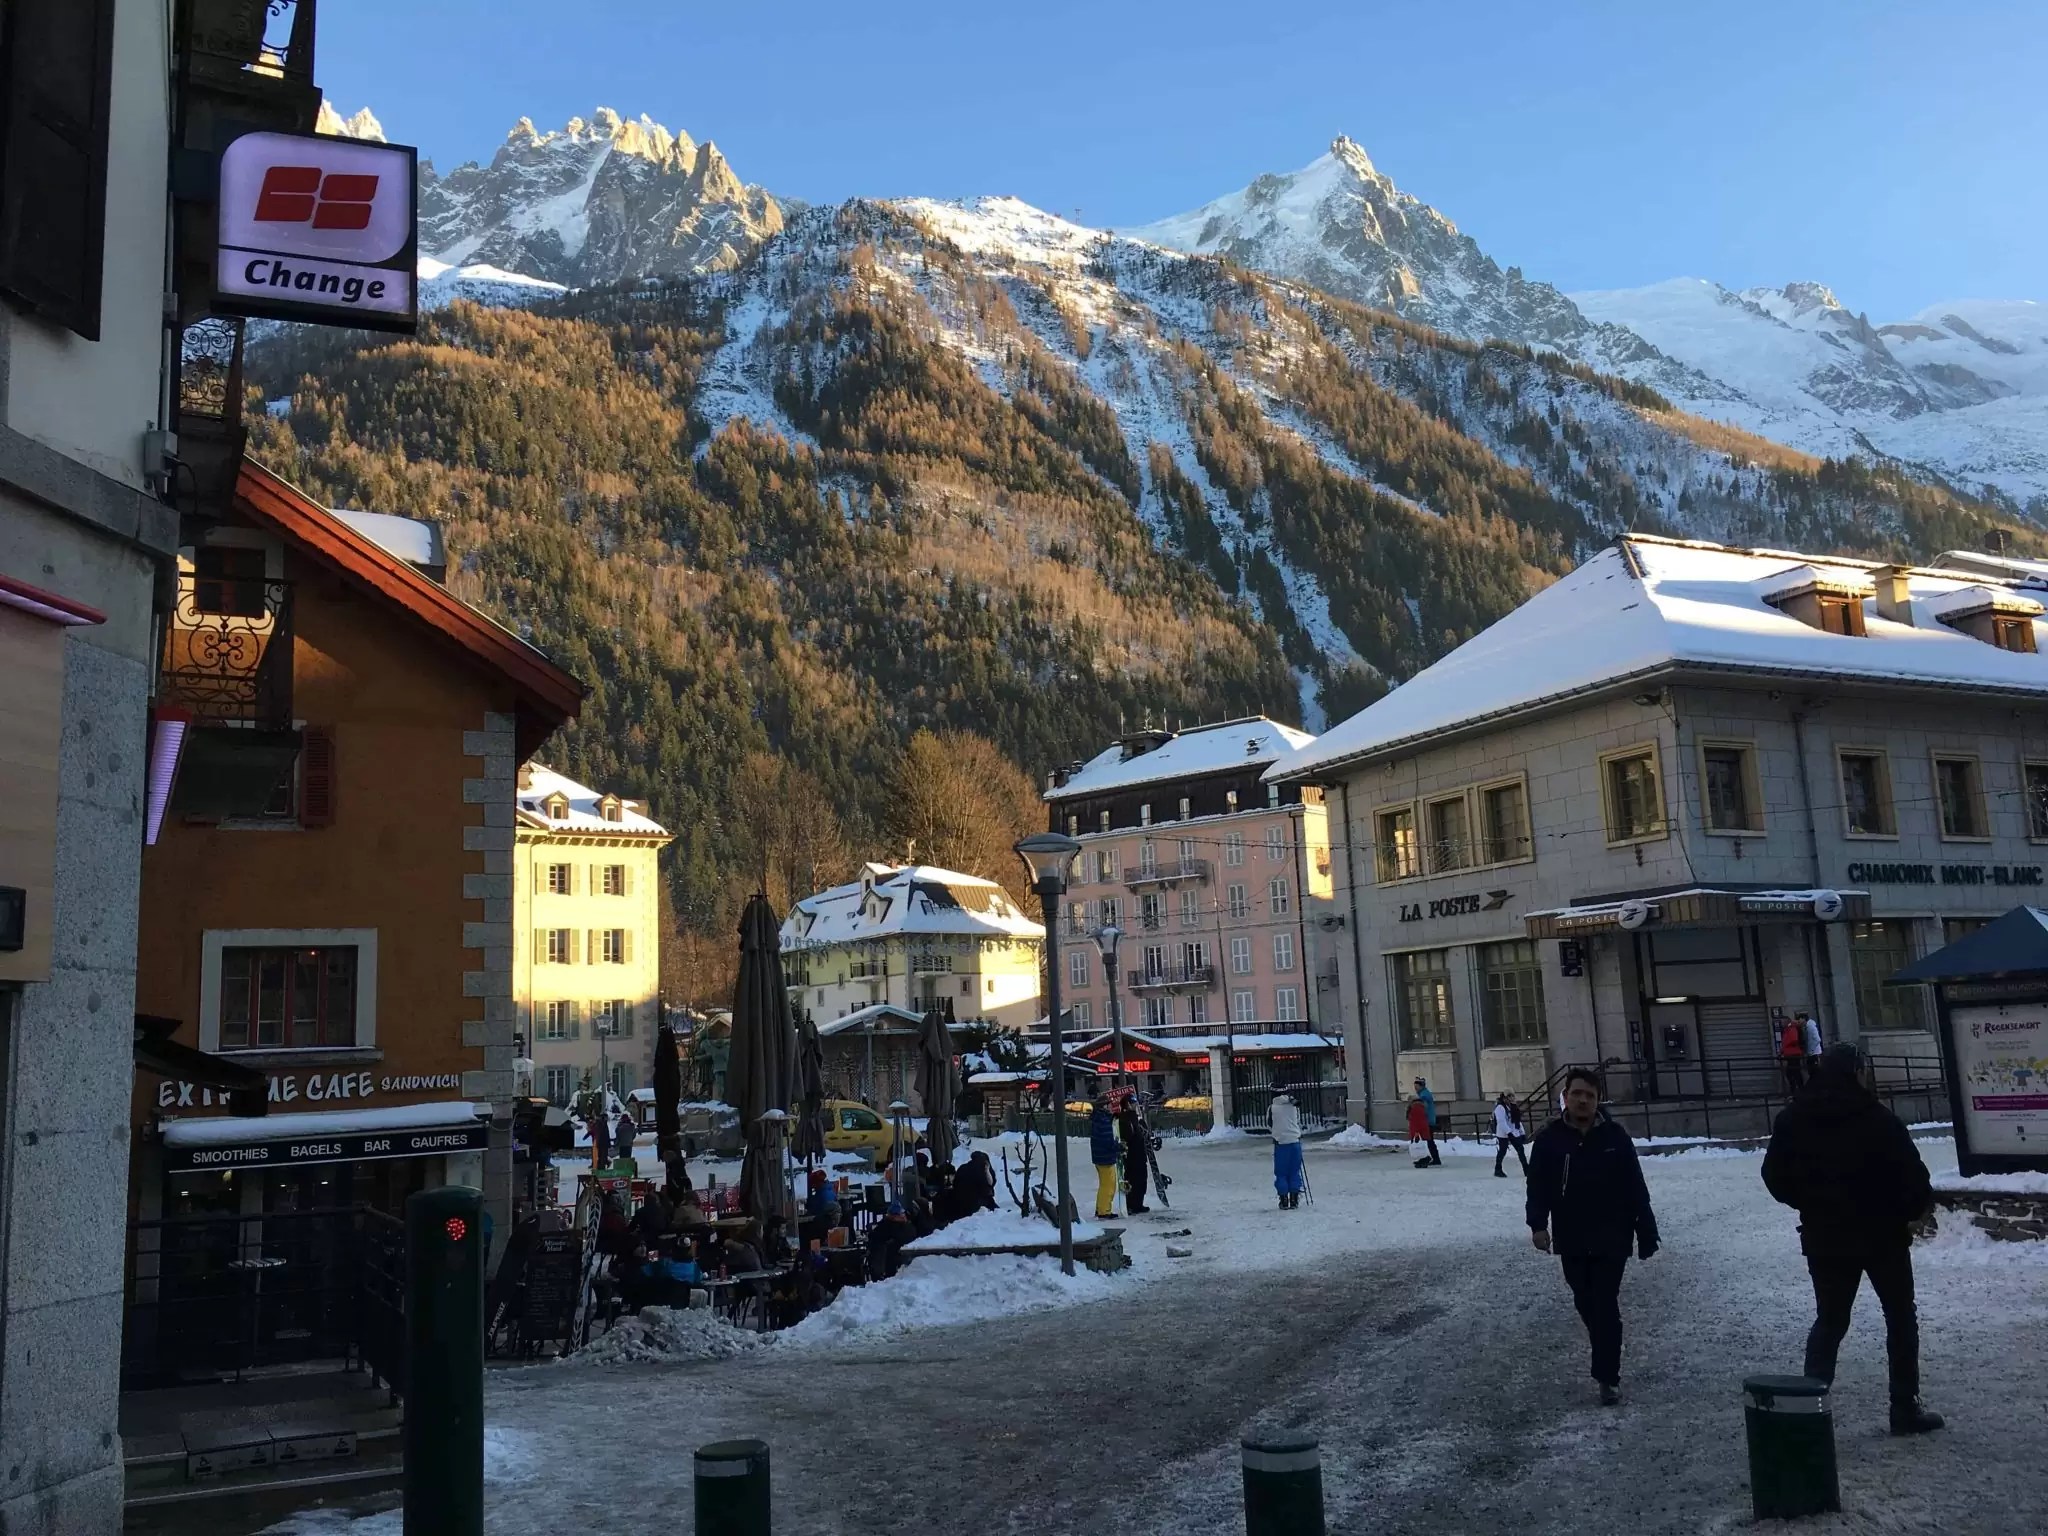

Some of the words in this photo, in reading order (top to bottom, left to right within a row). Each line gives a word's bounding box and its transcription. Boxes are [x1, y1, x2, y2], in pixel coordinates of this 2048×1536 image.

[244, 259, 385, 302] Change
[1848, 862, 1936, 884] CHAMONIX
[1940, 864, 2044, 886] MONT-BLANC
[1399, 903, 1423, 922] LA
[1428, 894, 1480, 919] POSTE
[1768, 902, 1805, 910] POSTE
[1559, 919, 1573, 927] LA
[1579, 914, 1616, 924] POSTE
[1984, 1021, 2042, 1035] RECENSEMENT
[158, 1075, 299, 1108] EXME
[306, 1071, 374, 1101] CAFE
[381, 1073, 460, 1091] SANDWICH
[192, 1147, 269, 1164] SMOOTHIES
[290, 1143, 342, 1157] BAGELS
[364, 1139, 391, 1152] BAR
[411, 1134, 468, 1148] GAUFRES
